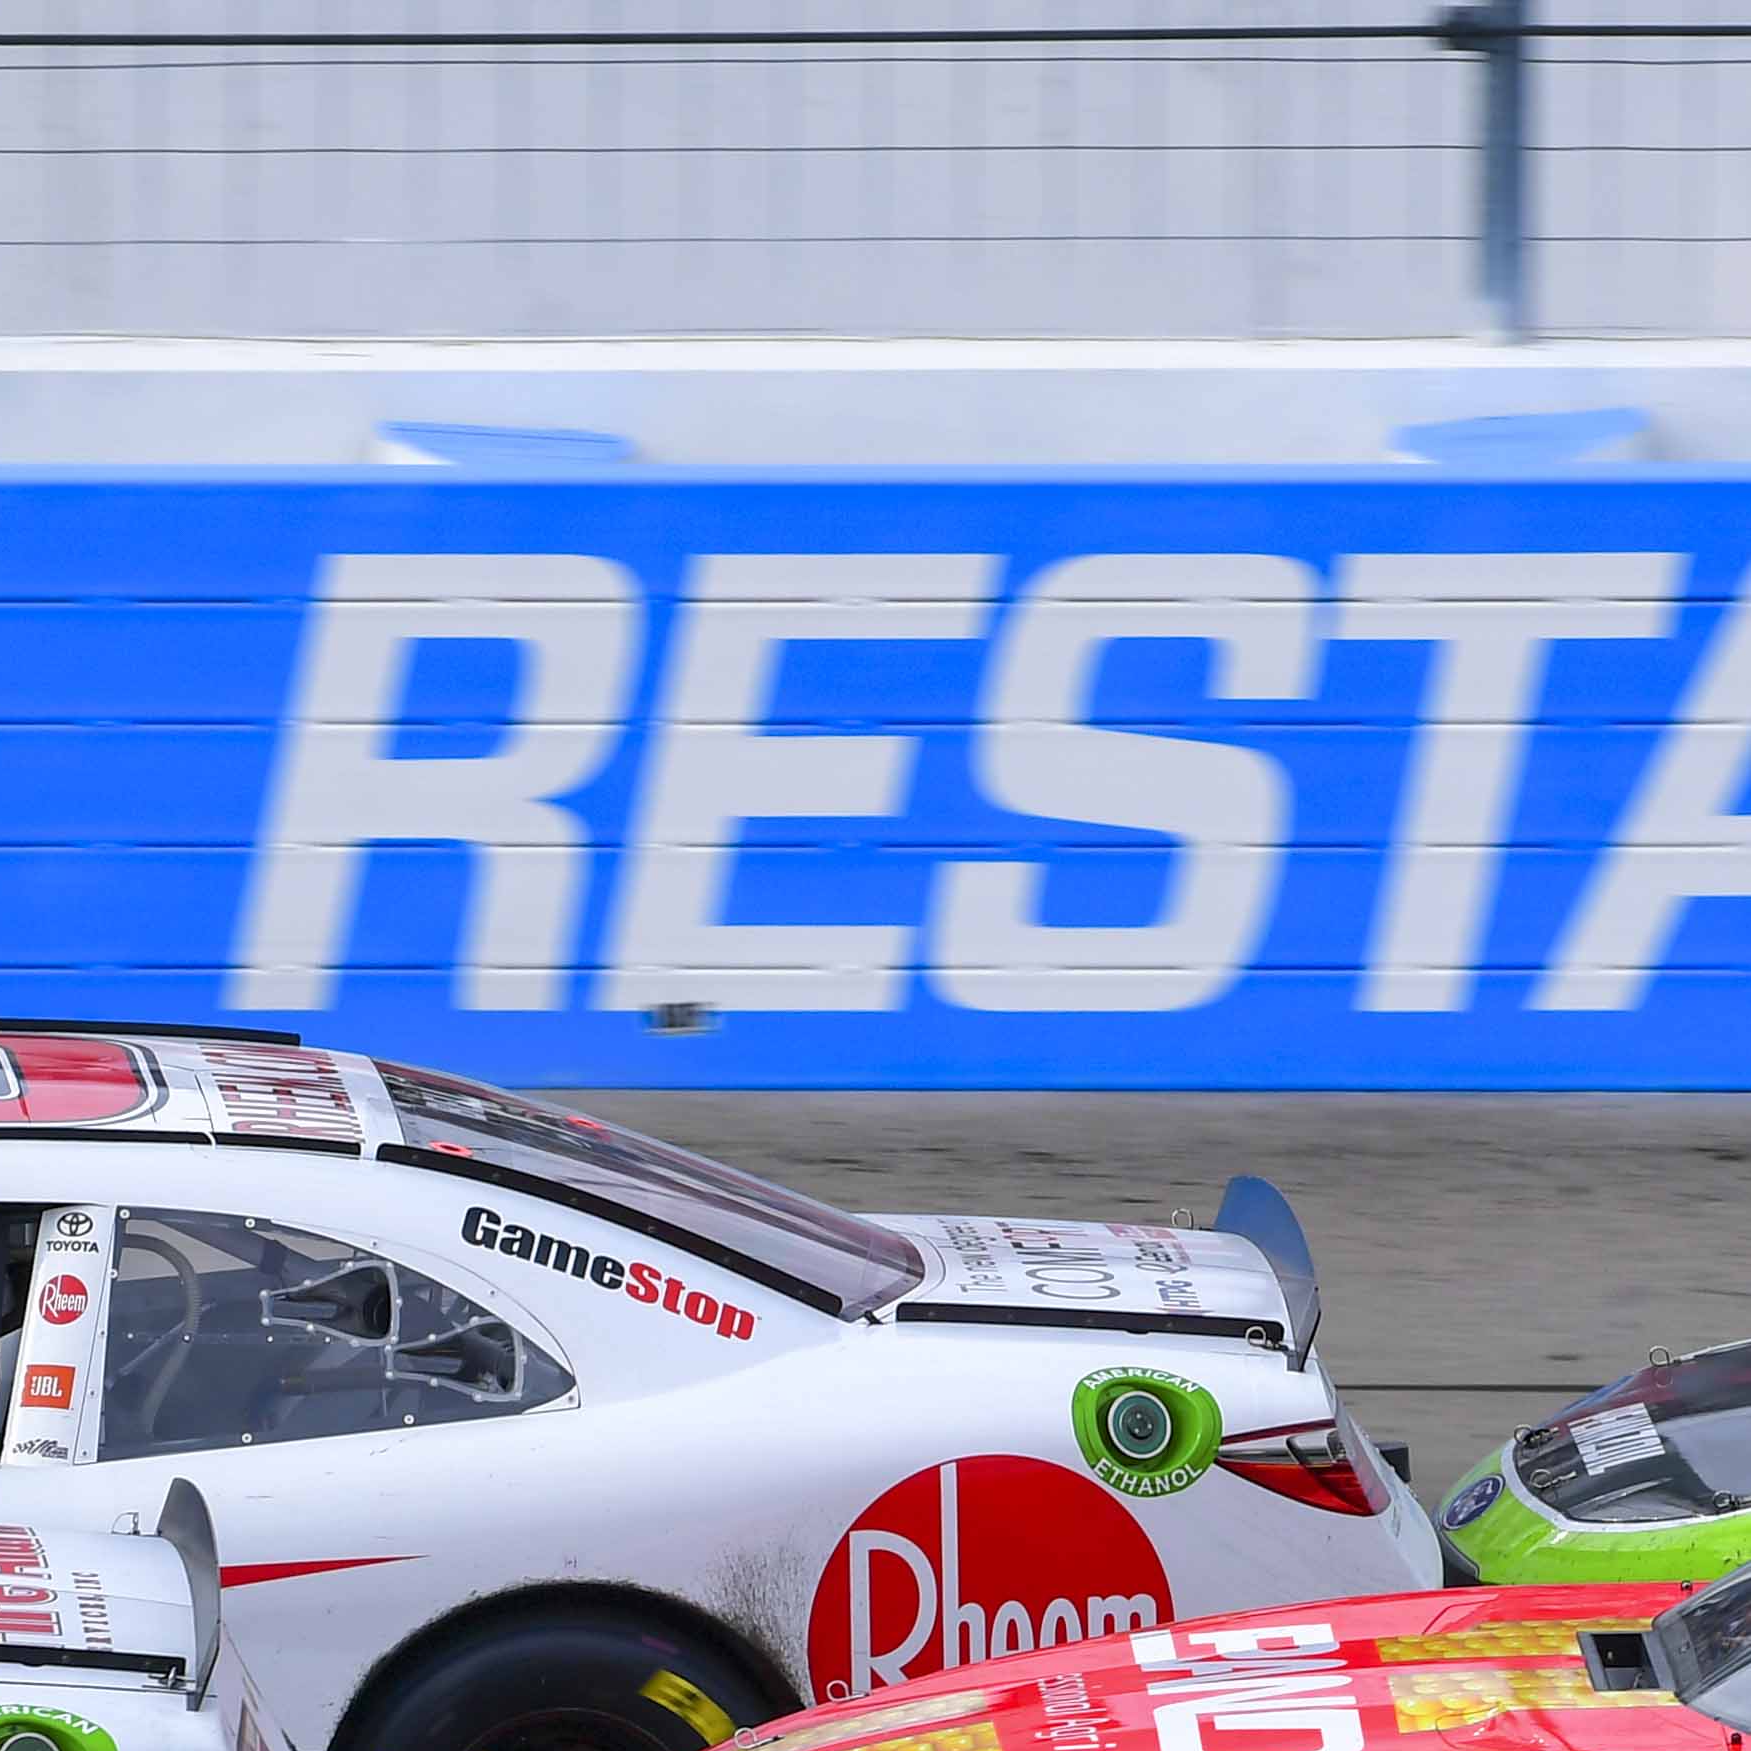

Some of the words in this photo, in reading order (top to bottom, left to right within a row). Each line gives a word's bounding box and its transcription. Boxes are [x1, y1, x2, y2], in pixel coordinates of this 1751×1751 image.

[46, 1240, 99, 1253] TOYOTA
[460, 1206, 755, 1342] GameStop
[41, 1274, 86, 1318] Rheem
[30, 1375, 63, 1398] JBL
[1082, 1366, 1200, 1394] AMERICAN
[1093, 1456, 1204, 1496] ETHANOL
